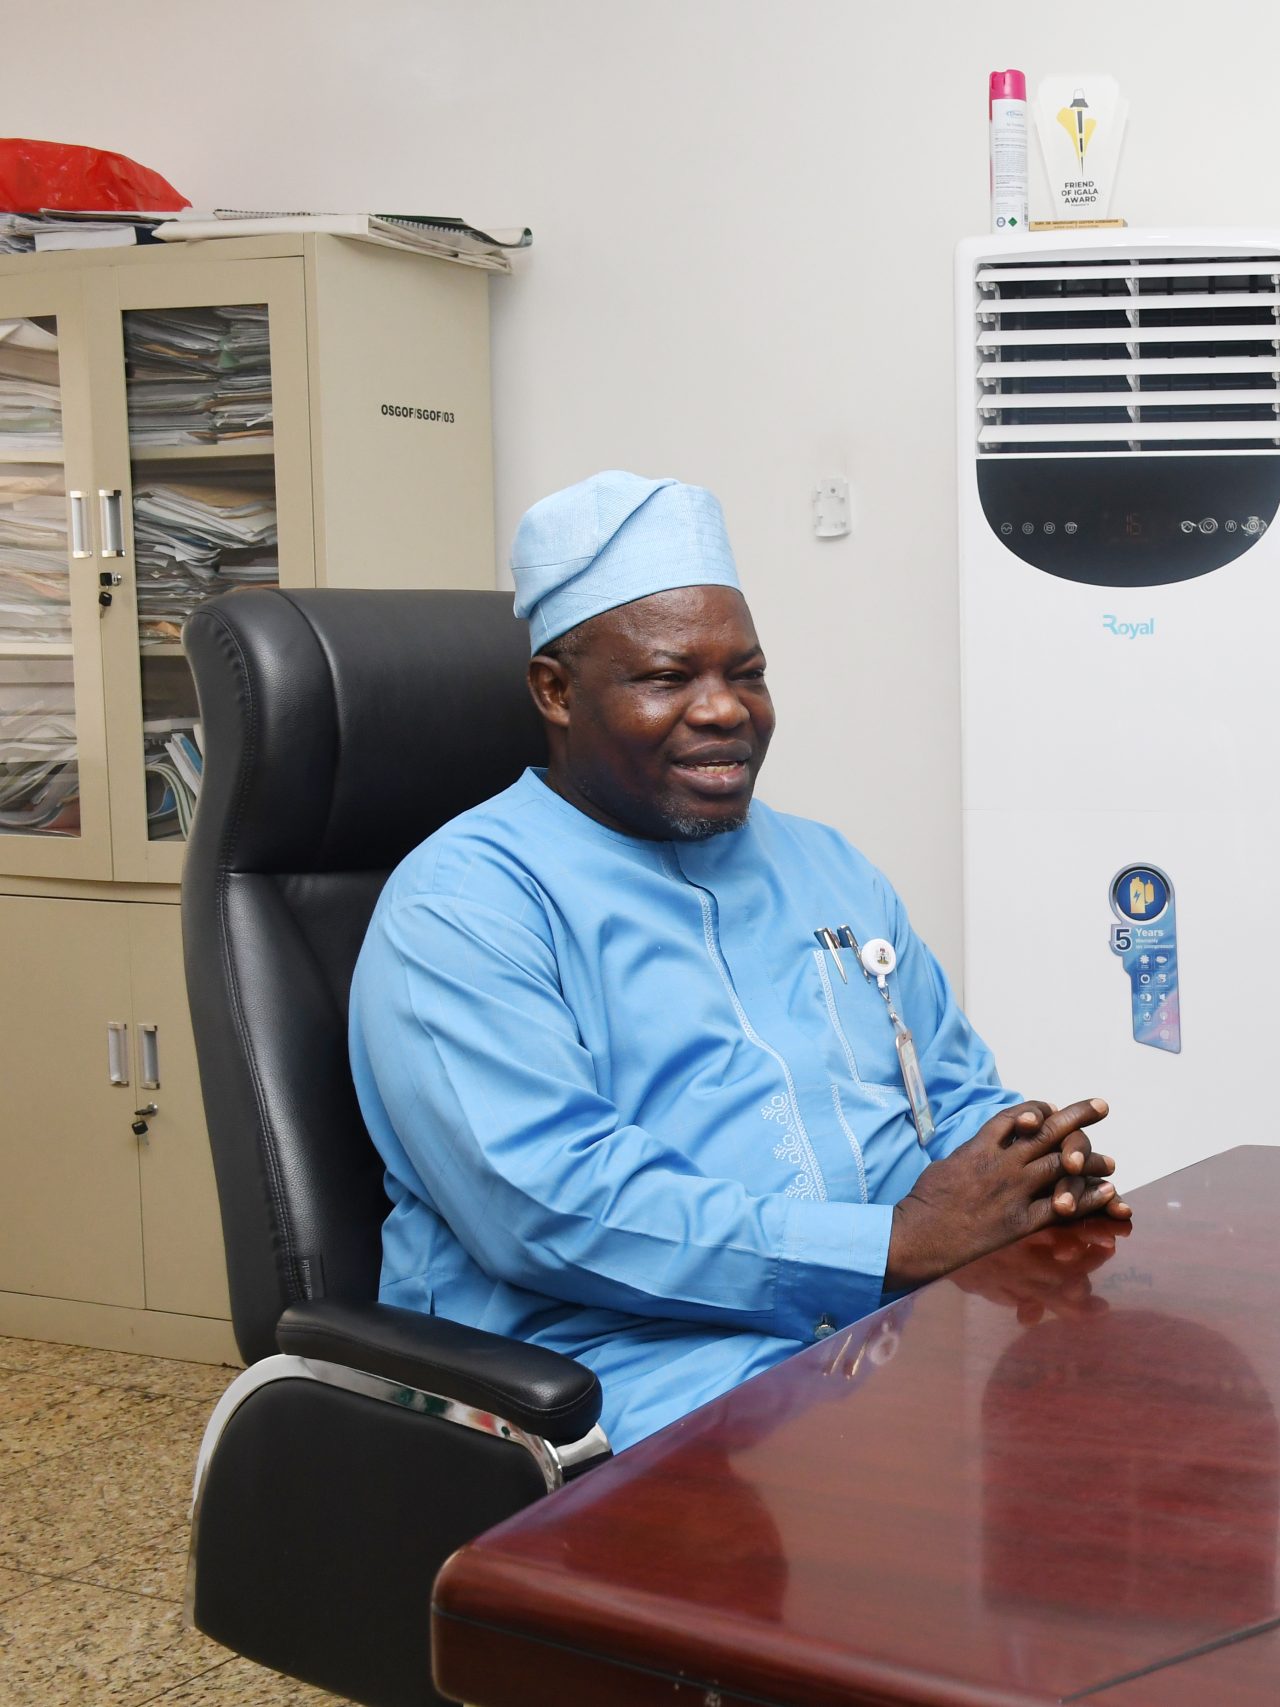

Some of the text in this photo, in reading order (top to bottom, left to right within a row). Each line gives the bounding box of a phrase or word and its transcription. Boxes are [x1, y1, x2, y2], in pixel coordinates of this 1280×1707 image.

[1064, 181, 1094, 189] FRIEND
[1061, 188, 1098, 197] OF IGALA
[1064, 195, 1096, 204] AWARD
[381, 404, 455, 423] OSGOF/SGOF/03
[1102, 614, 1155, 639] Royal
[1114, 927, 1164, 951] 5 Years
